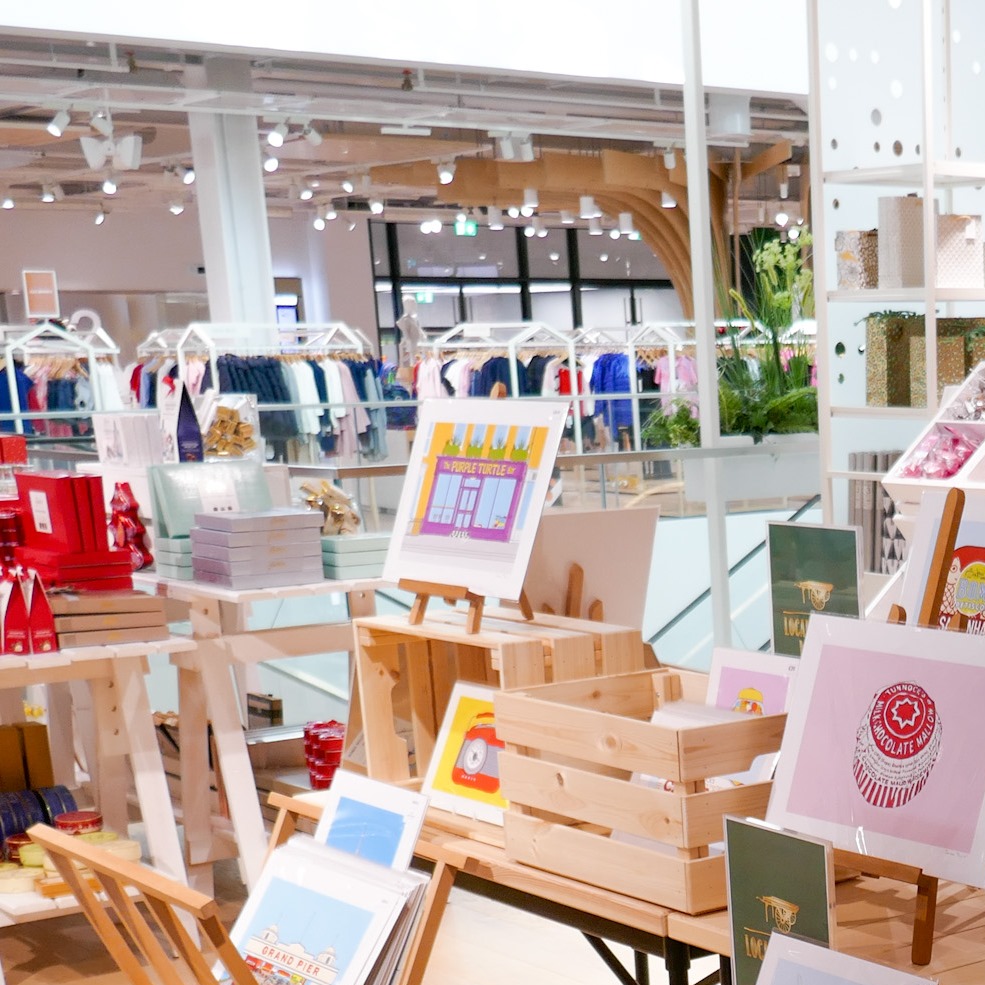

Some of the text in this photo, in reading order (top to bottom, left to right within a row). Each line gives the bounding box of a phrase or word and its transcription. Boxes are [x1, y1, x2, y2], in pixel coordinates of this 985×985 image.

[451, 461, 476, 475] PURPLE
[478, 463, 506, 476] TURTLE
[873, 719, 915, 756] CHOCOLATE
[916, 706, 935, 748] MALLOW
[261, 945, 321, 977] GRAND PIER
[744, 934, 770, 961] LOC
